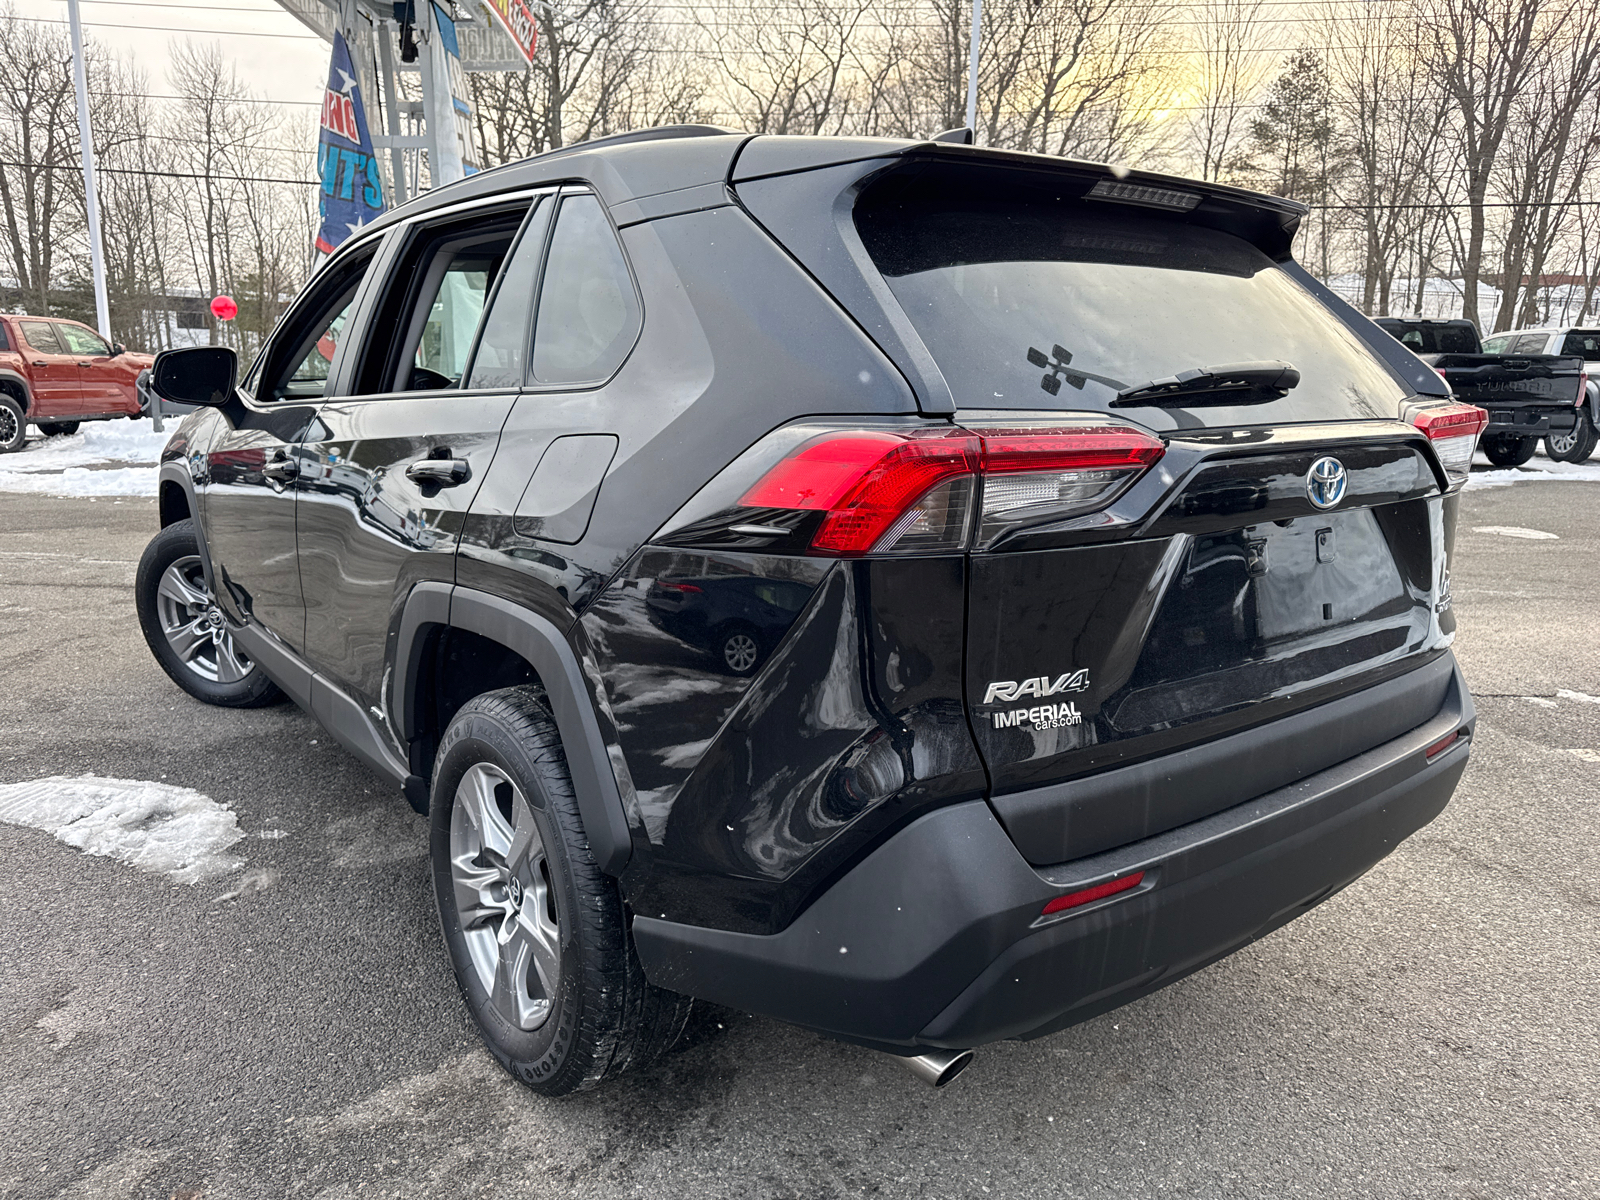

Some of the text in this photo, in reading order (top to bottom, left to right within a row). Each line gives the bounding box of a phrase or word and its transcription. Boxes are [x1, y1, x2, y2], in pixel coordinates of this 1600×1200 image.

[1476, 381, 1553, 394] TUNDRA
[983, 668, 1090, 704] RAV4
[993, 701, 1082, 729] IMPERIAL
[1035, 715, 1082, 731] cars.com
